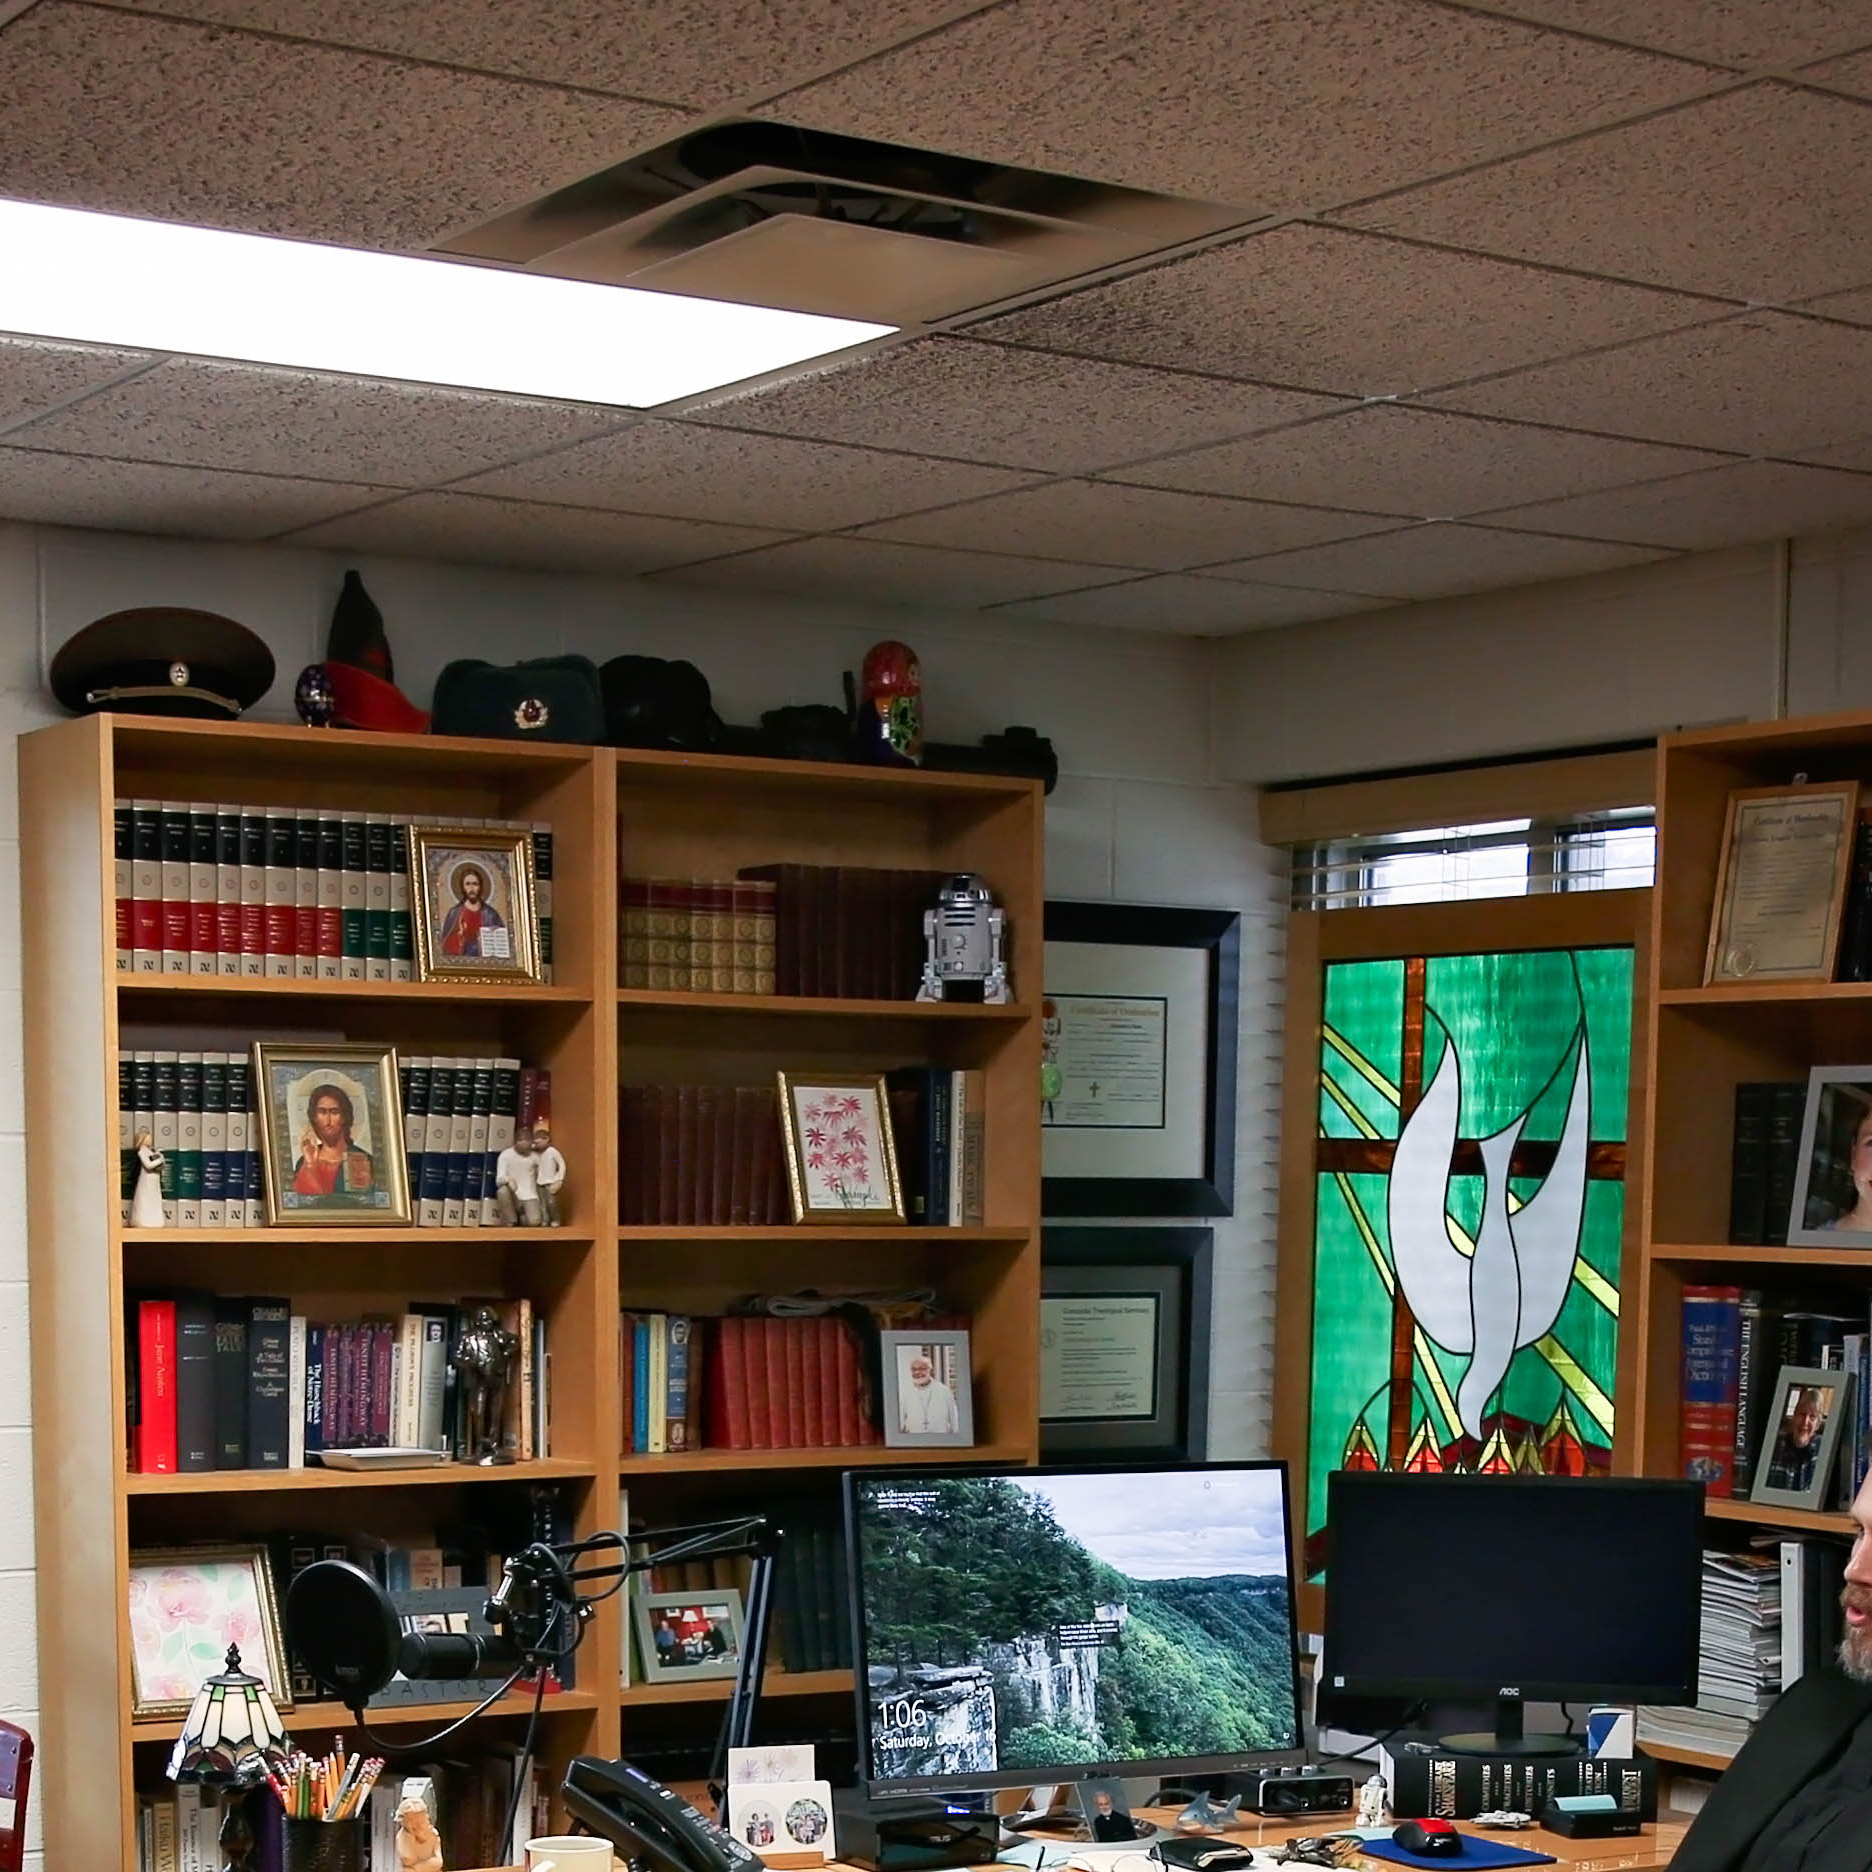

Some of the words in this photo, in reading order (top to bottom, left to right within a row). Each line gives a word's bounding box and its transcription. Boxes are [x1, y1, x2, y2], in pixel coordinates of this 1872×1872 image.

[1741, 1319, 1752, 1342] THE
[1739, 1343, 1751, 1391] ENGLISH
[1735, 1391, 1748, 1448] LANGUAGE
[1499, 1687, 1520, 1696] AOC
[878, 1699, 927, 1729] 1:06
[880, 1733, 933, 1750] Saturday,
[935, 1730, 982, 1746] October
[1481, 1764, 1491, 1812] COMEDIES
[1524, 1765, 1534, 1812] HISTORIES
